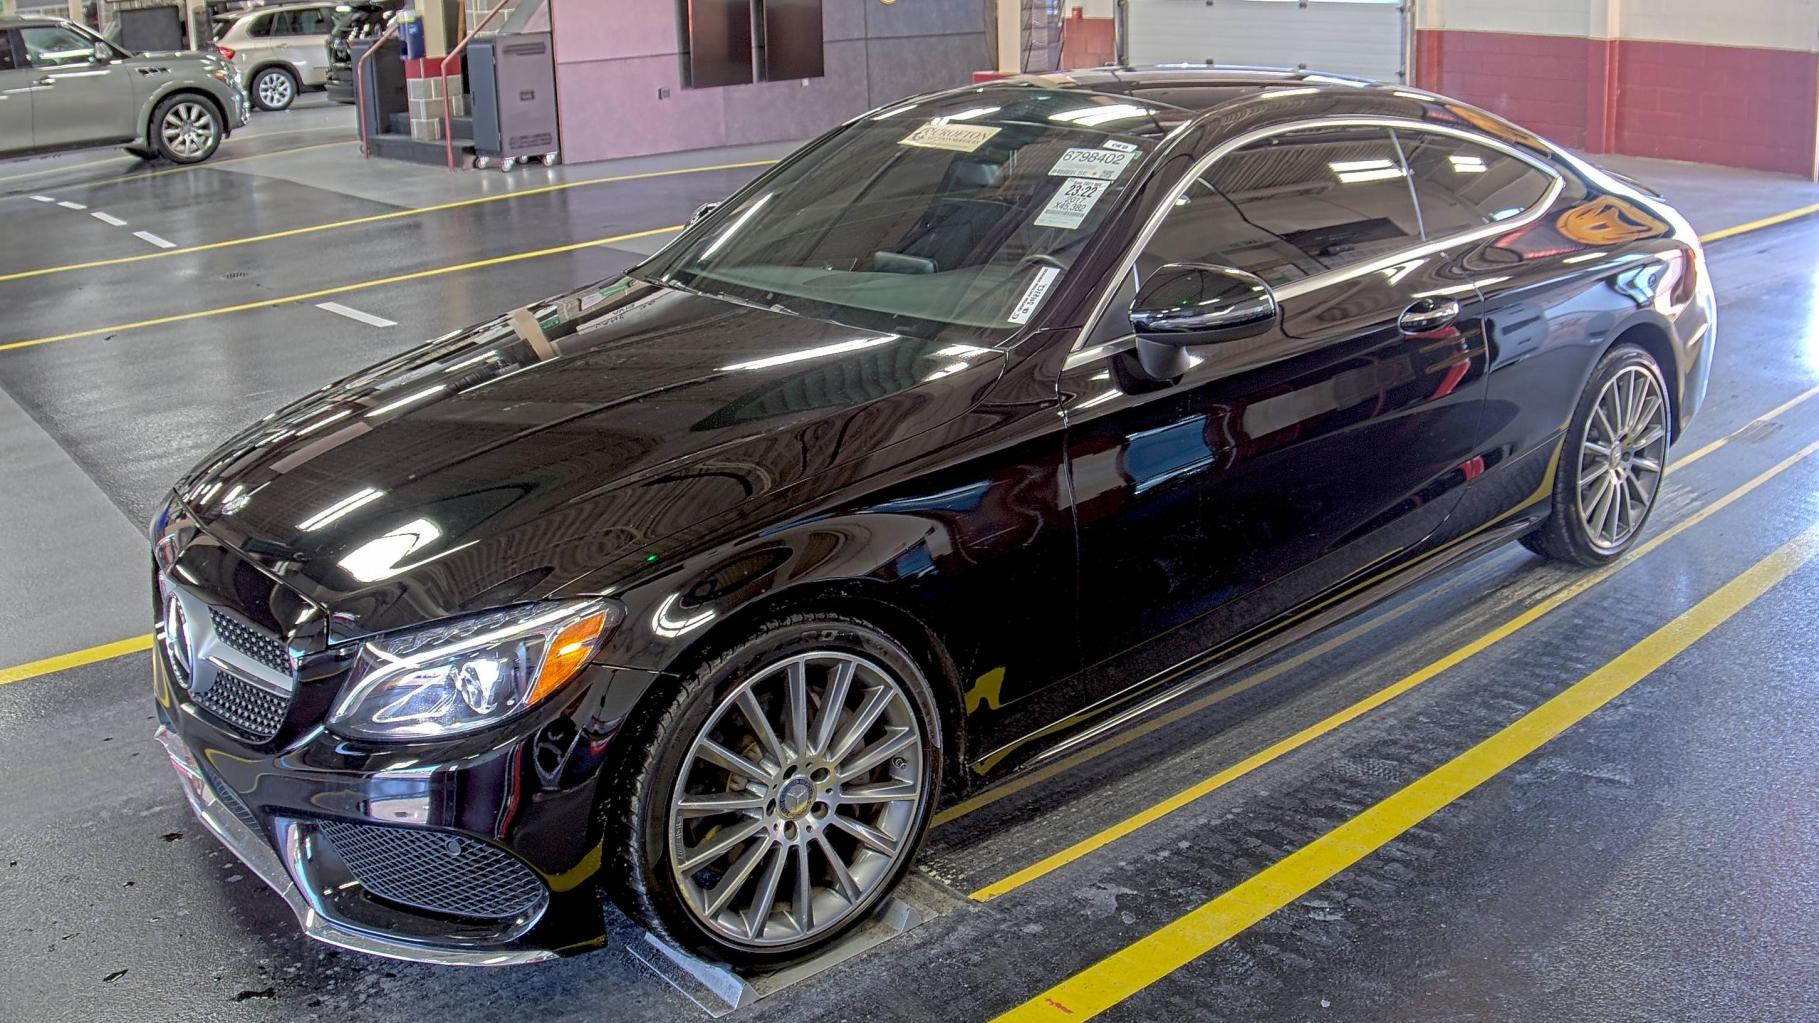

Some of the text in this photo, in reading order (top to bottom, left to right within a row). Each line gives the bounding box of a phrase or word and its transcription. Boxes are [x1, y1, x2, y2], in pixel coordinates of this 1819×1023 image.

[1062, 150, 1125, 165] 6798402
[1064, 184, 1098, 198] 23:22
[1064, 196, 1086, 204] 2017
